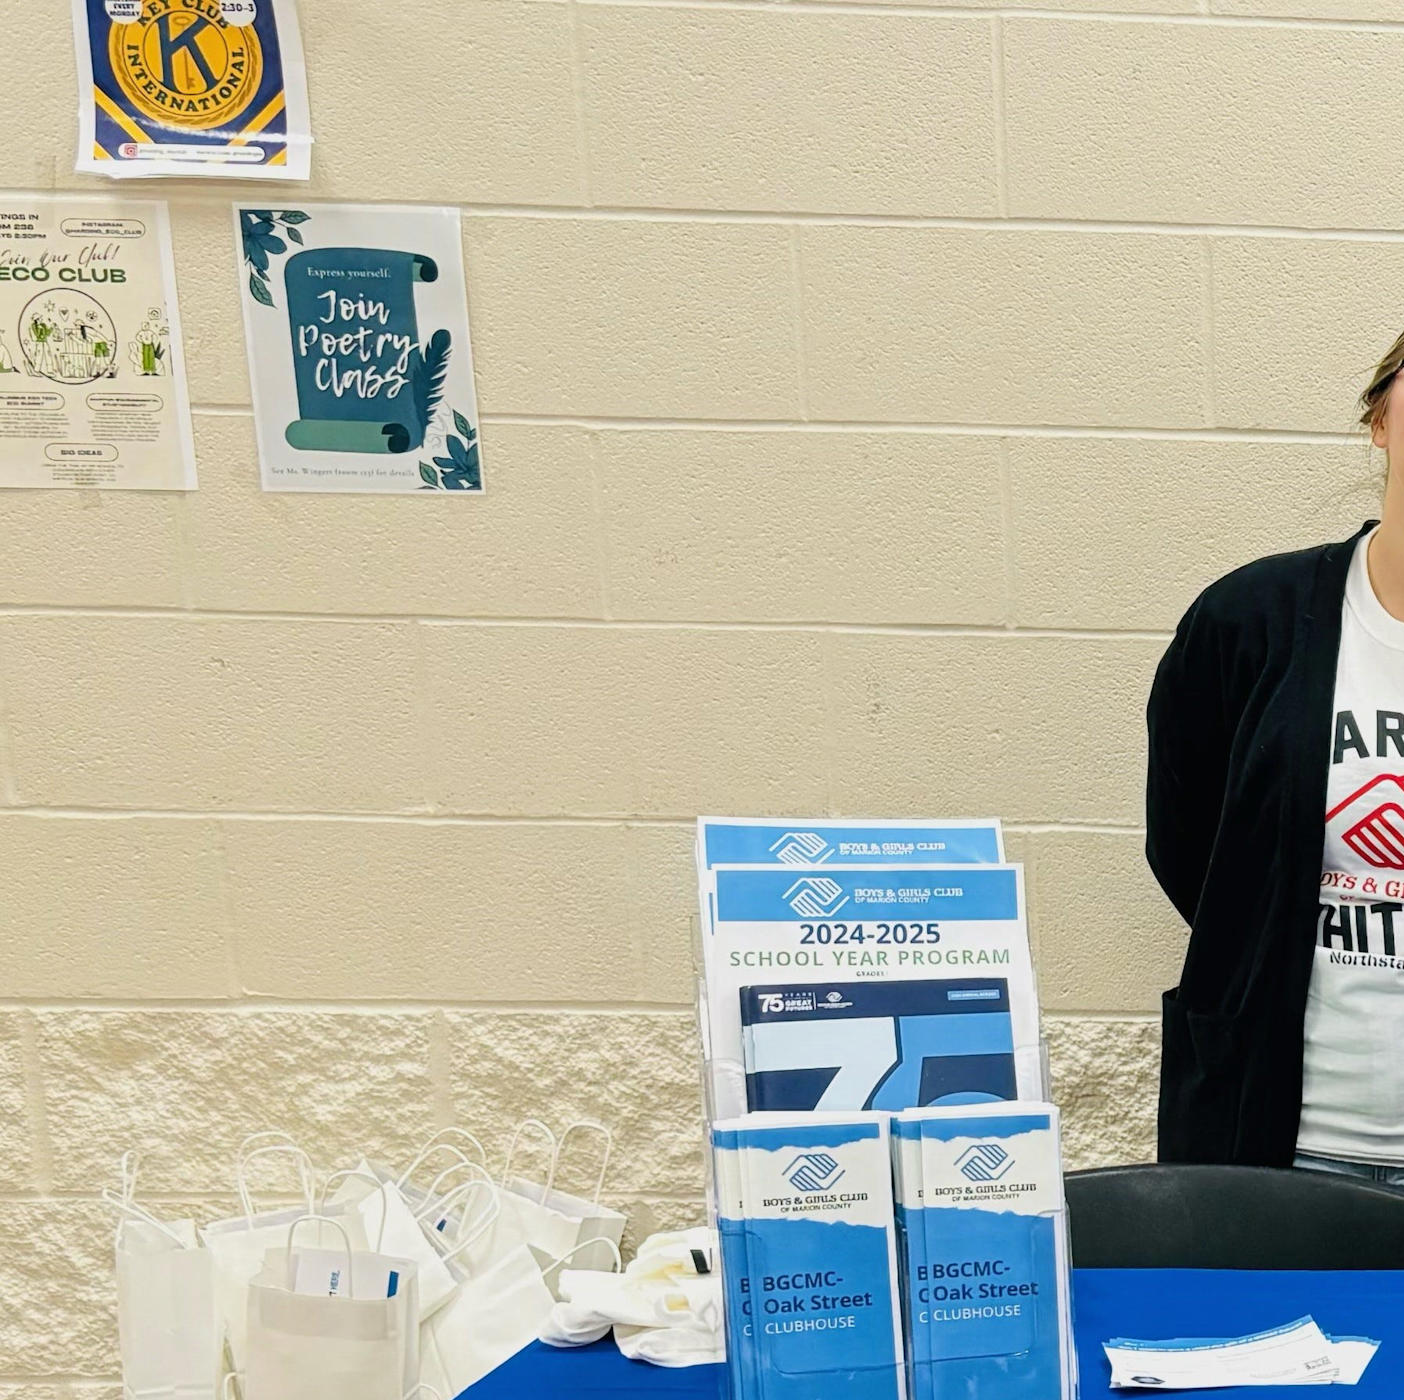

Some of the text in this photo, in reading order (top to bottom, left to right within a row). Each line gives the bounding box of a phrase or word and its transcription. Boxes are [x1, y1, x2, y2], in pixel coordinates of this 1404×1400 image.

[127, 44, 245, 113] INTERNATIONAL
[58, 268, 126, 283] CLUB
[307, 267, 391, 280] Express yourself.
[317, 290, 390, 325] Join
[299, 325, 420, 374] Poetry
[315, 358, 410, 399] Class
[1363, 877, 1377, 894] &
[800, 923, 941, 944] 2024-2025
[730, 948, 1010, 966] SCHOOL YEAR PROGRAM
[758, 993, 785, 1012] 75
[935, 1187, 963, 1196] BOYS
[965, 1187, 974, 1195] &
[763, 1198, 791, 1207] BOYS
[794, 1197, 803, 1205] &
[932, 1260, 1010, 1279] BGCMC-
[763, 1272, 843, 1292] BGCMC-
[934, 1281, 1039, 1302] Oak Street
[764, 1292, 873, 1314] Oak Street
[934, 1305, 1021, 1323] CLUBHOUSE
[765, 1315, 856, 1336] CLUBHOUSE
